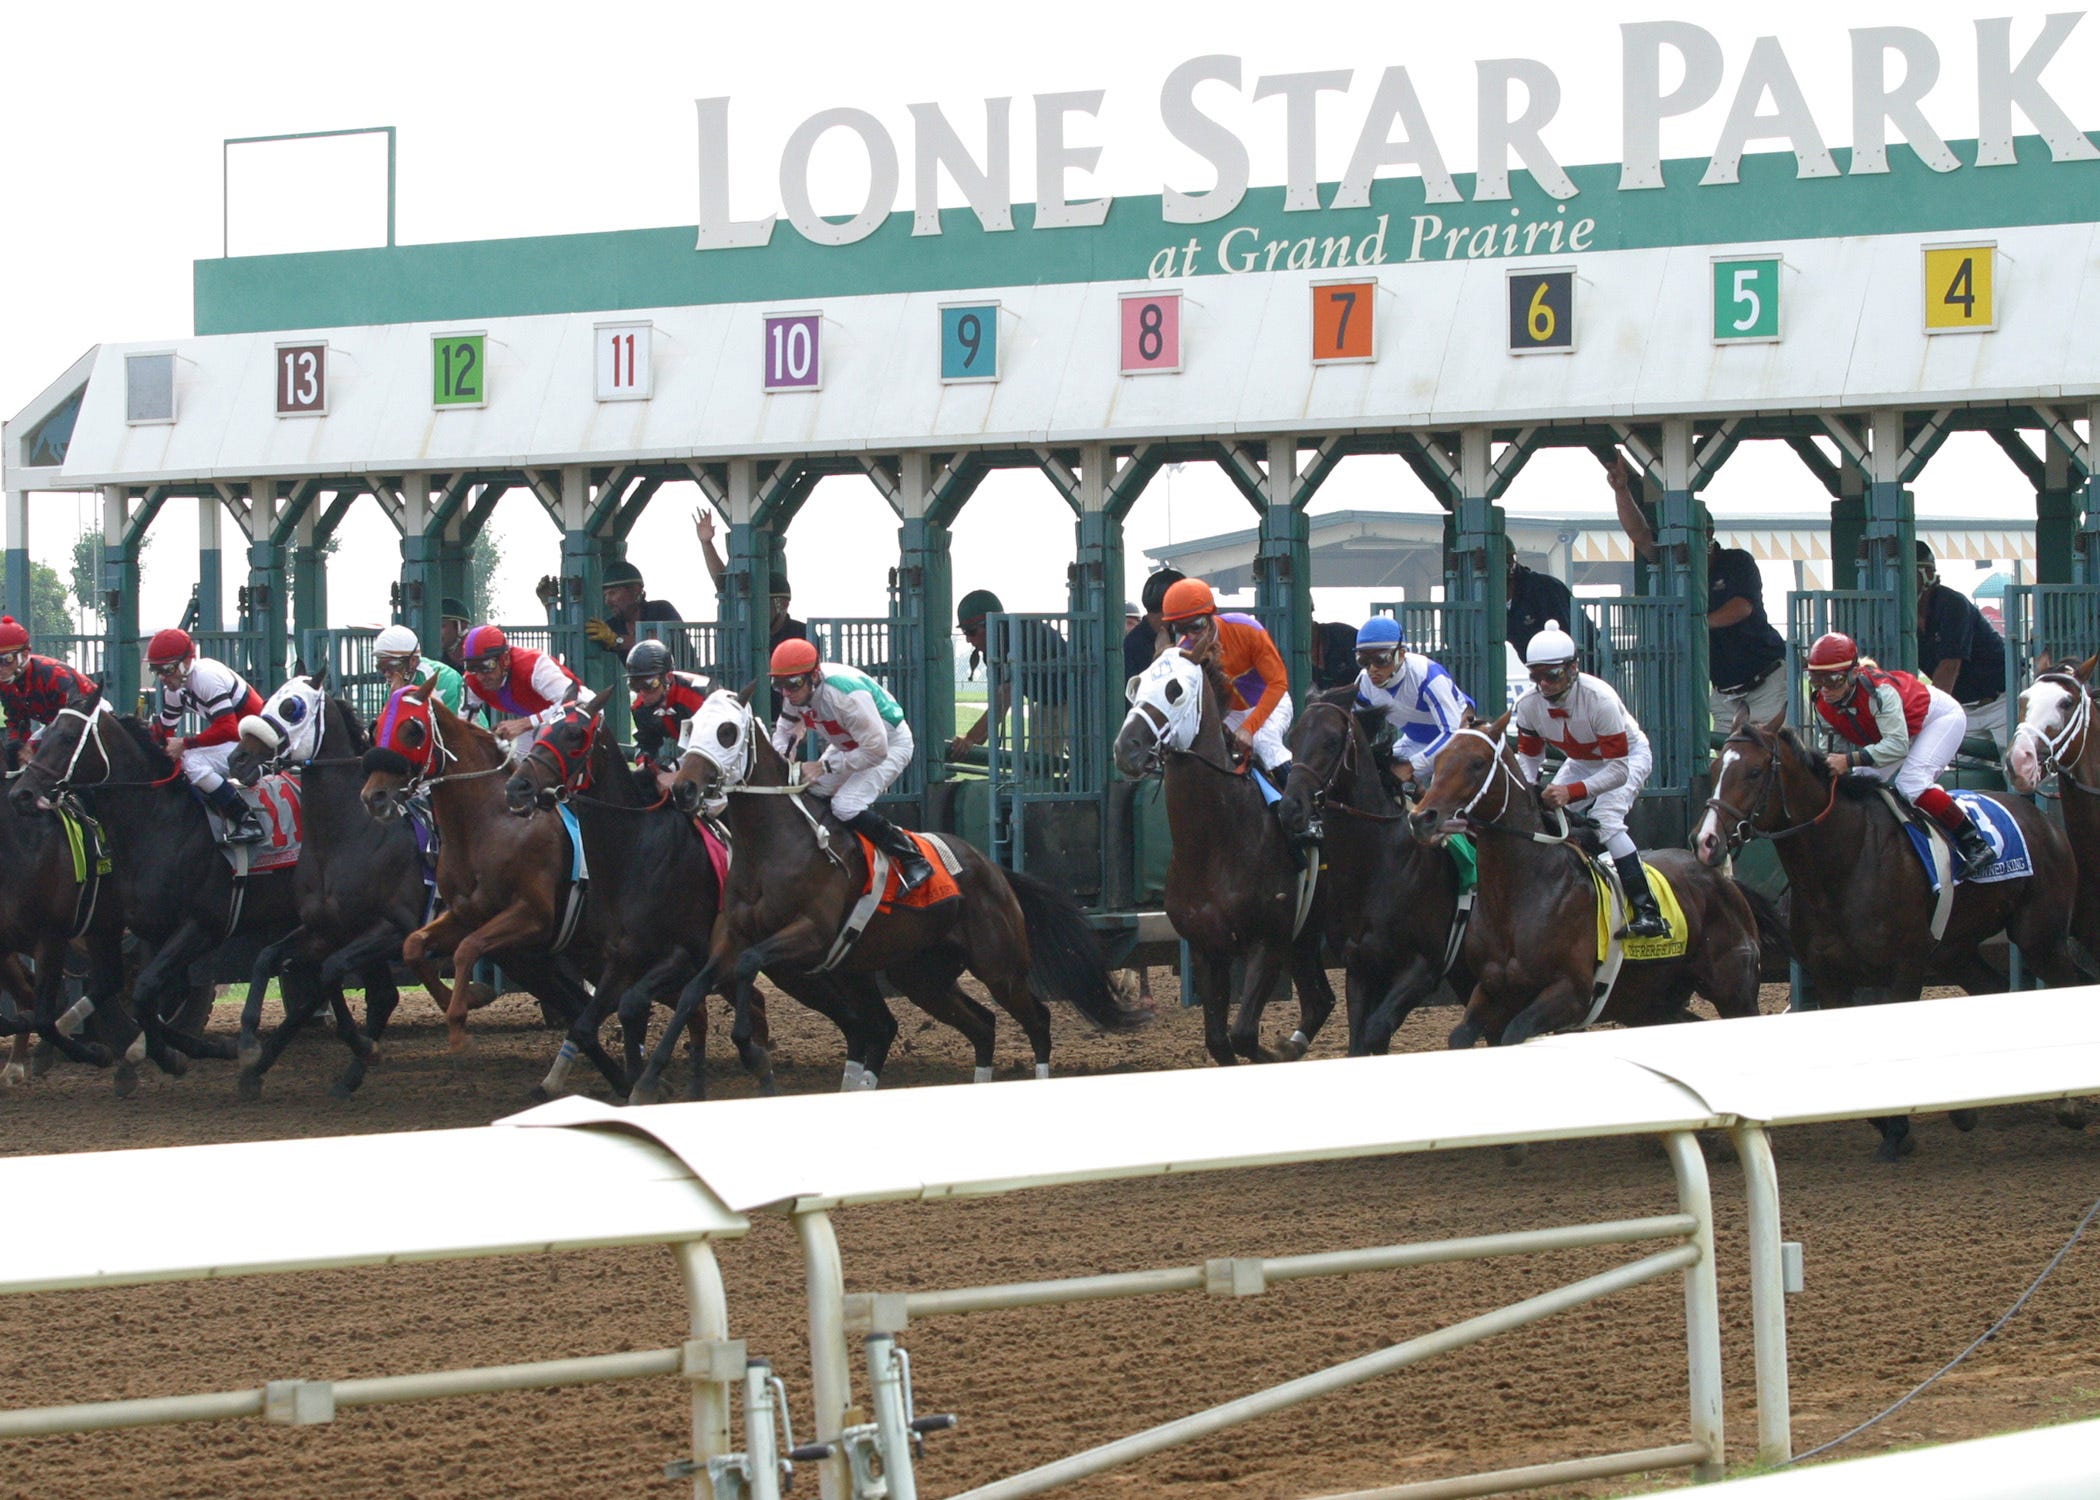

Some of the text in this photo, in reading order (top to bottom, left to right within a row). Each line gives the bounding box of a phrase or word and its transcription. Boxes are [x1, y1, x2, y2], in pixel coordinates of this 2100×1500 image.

[694, 11, 2100, 251] LONE STAR PARK
[1147, 204, 1596, 280] at Grand Prairie
[1527, 281, 1556, 341] 6
[1732, 269, 1761, 331] 5
[1943, 257, 1976, 319] 4
[957, 314, 981, 369] 9
[1138, 303, 1163, 361] 8
[1331, 292, 1356, 349] 7
[284, 351, 318, 406] 13
[441, 343, 477, 398] 12
[611, 333, 636, 388] 11
[772, 322, 812, 380] 10
[1954, 797, 2005, 860] 3
[2006, 857, 2026, 873] KING
